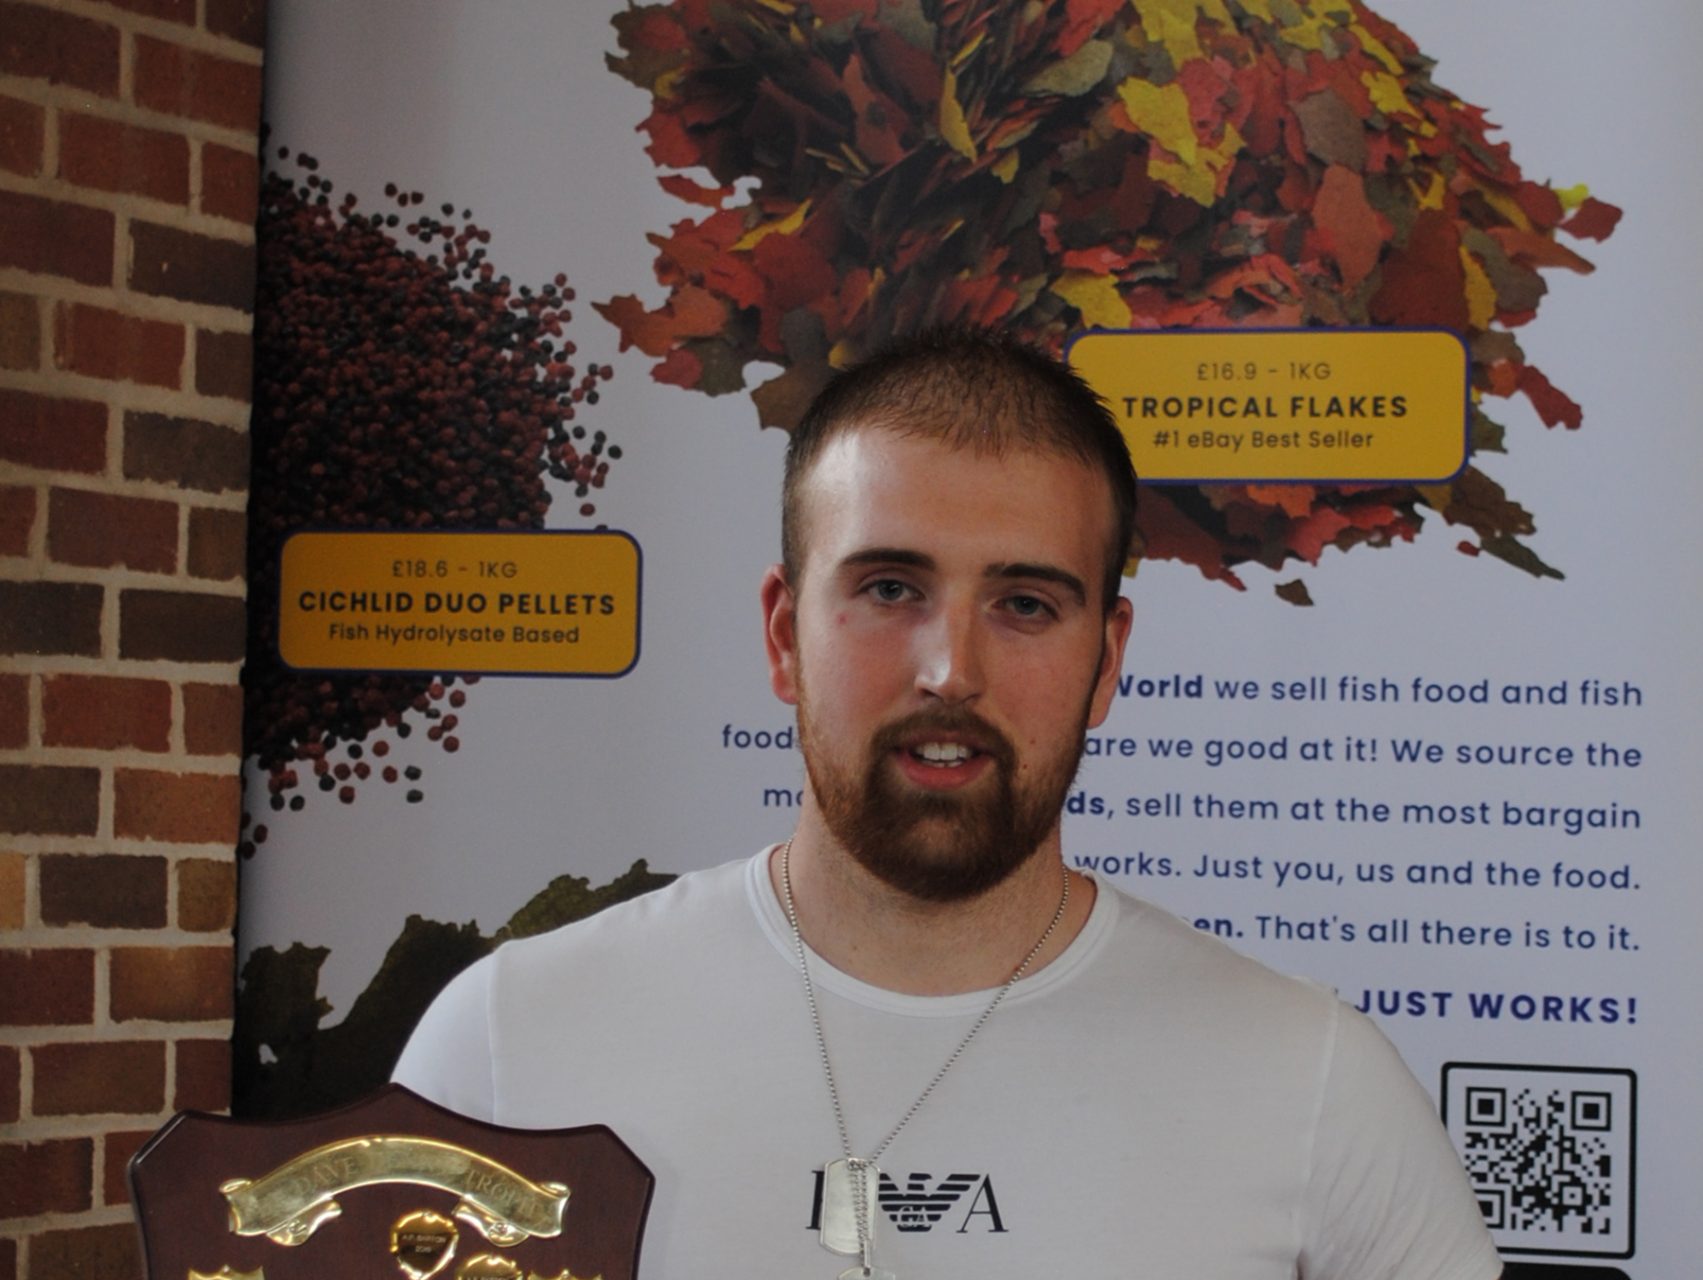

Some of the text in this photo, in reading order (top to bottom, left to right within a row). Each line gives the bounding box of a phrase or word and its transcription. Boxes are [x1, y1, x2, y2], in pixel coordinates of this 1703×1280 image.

[1196, 361, 1257, 382] £16.9
[1289, 361, 1332, 381] 1KG
[1121, 395, 1407, 419] TROPICAL FLAKES
[1153, 430, 1374, 454] #1 eBay Best Seller
[391, 559, 448, 579] £18.6
[478, 560, 518, 579] 1KG
[299, 591, 615, 616] CICHLID DUO PELLETS
[329, 623, 580, 647] Fish Hydrolysate Based
[1214, 680, 1260, 700] we
[1271, 676, 1327, 701] sell
[1338, 675, 1399, 702] fish
[1411, 677, 1489, 704] food
[1501, 680, 1568, 705] and
[1579, 679, 1642, 706] fish
[1084, 737, 1137, 757] are
[1147, 738, 1193, 758] we
[1204, 736, 1288, 767] good
[1299, 738, 1333, 761] at
[1345, 736, 1377, 762] it!
[1390, 739, 1444, 764] We
[1456, 744, 1574, 766] source
[1586, 742, 1642, 768] the
[1126, 793, 1181, 817] sell
[1193, 793, 1279, 820] them
[1290, 798, 1324, 821] at
[1335, 797, 1390, 823] the
[1403, 802, 1490, 825] most
[1503, 800, 1641, 836] bargain
[1074, 851, 1640, 890] works. Just you, us and the food.
[1255, 915, 1356, 942] That's
[1367, 919, 1408, 943] all
[1420, 920, 1512, 947] there
[1525, 921, 1550, 948] is
[1562, 925, 1596, 950] to
[1608, 924, 1639, 951] it.
[1354, 989, 1637, 1025] JUST WORKS!
